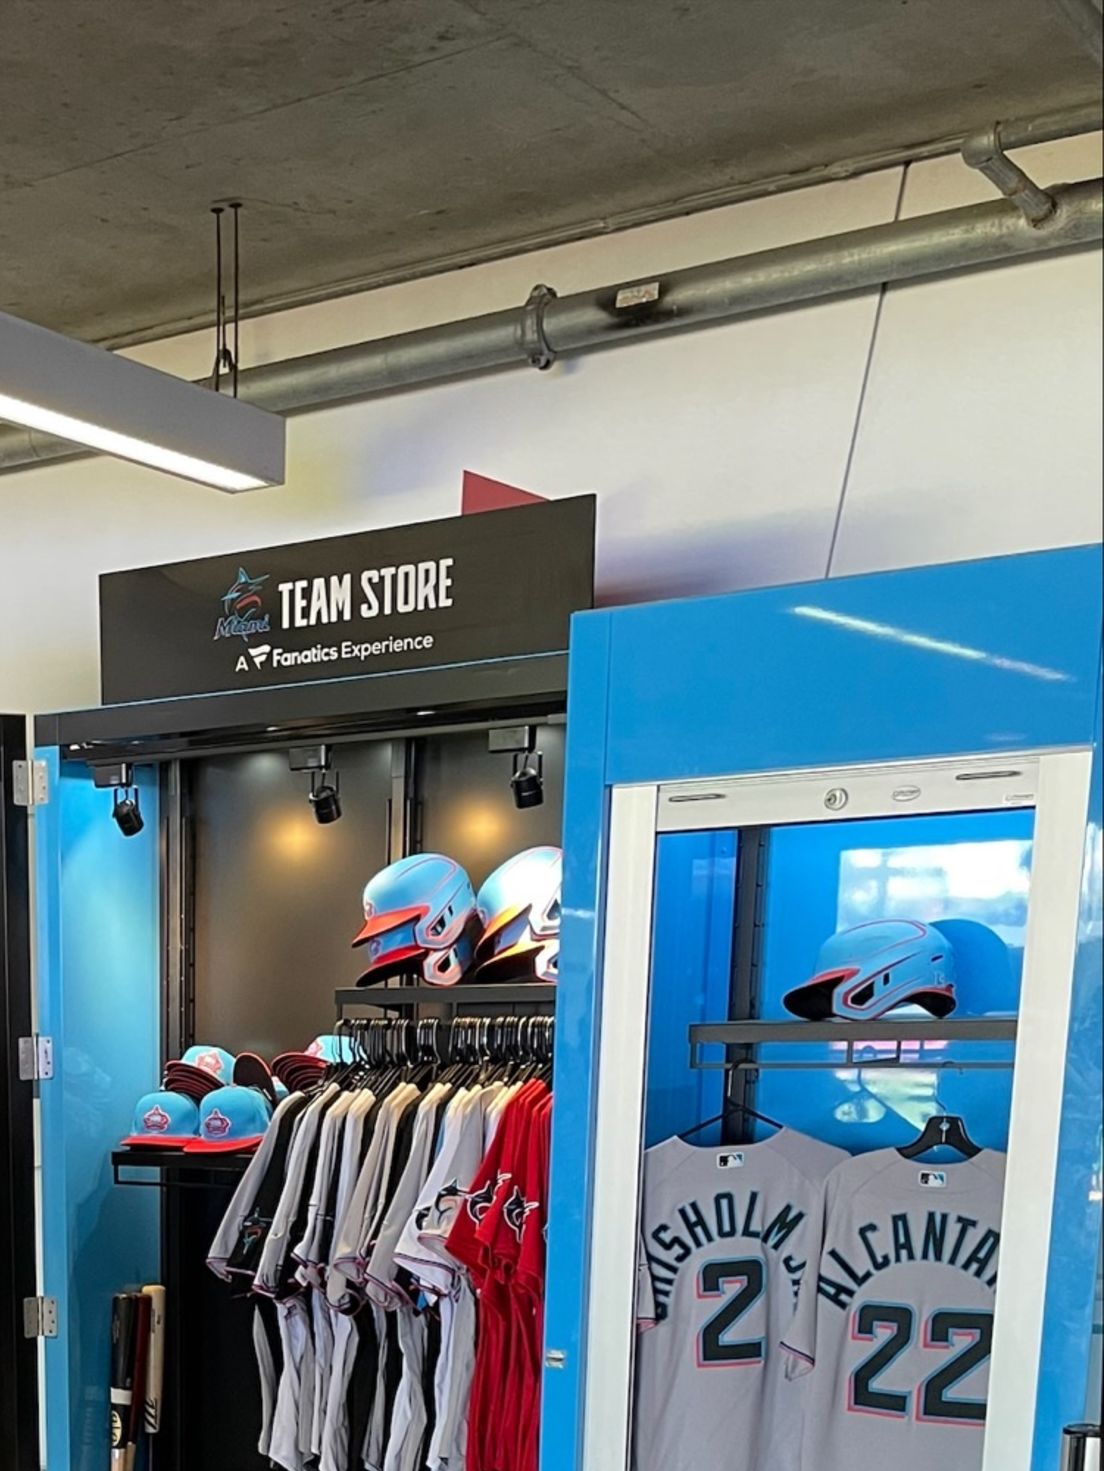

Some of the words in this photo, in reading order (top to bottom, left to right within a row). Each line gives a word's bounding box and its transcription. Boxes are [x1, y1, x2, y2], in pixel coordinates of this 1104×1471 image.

[213, 614, 271, 640] Miami
[278, 573, 352, 629] TEAM
[360, 557, 453, 618] STORE
[235, 655, 249, 672] A
[272, 644, 339, 668] Fanatics
[341, 634, 434, 661] Experience
[647, 1190, 805, 1322] ISHOLM
[817, 1211, 1001, 1311] ALCANTA
[697, 1256, 768, 1369] 2
[847, 1300, 994, 1428] 22
